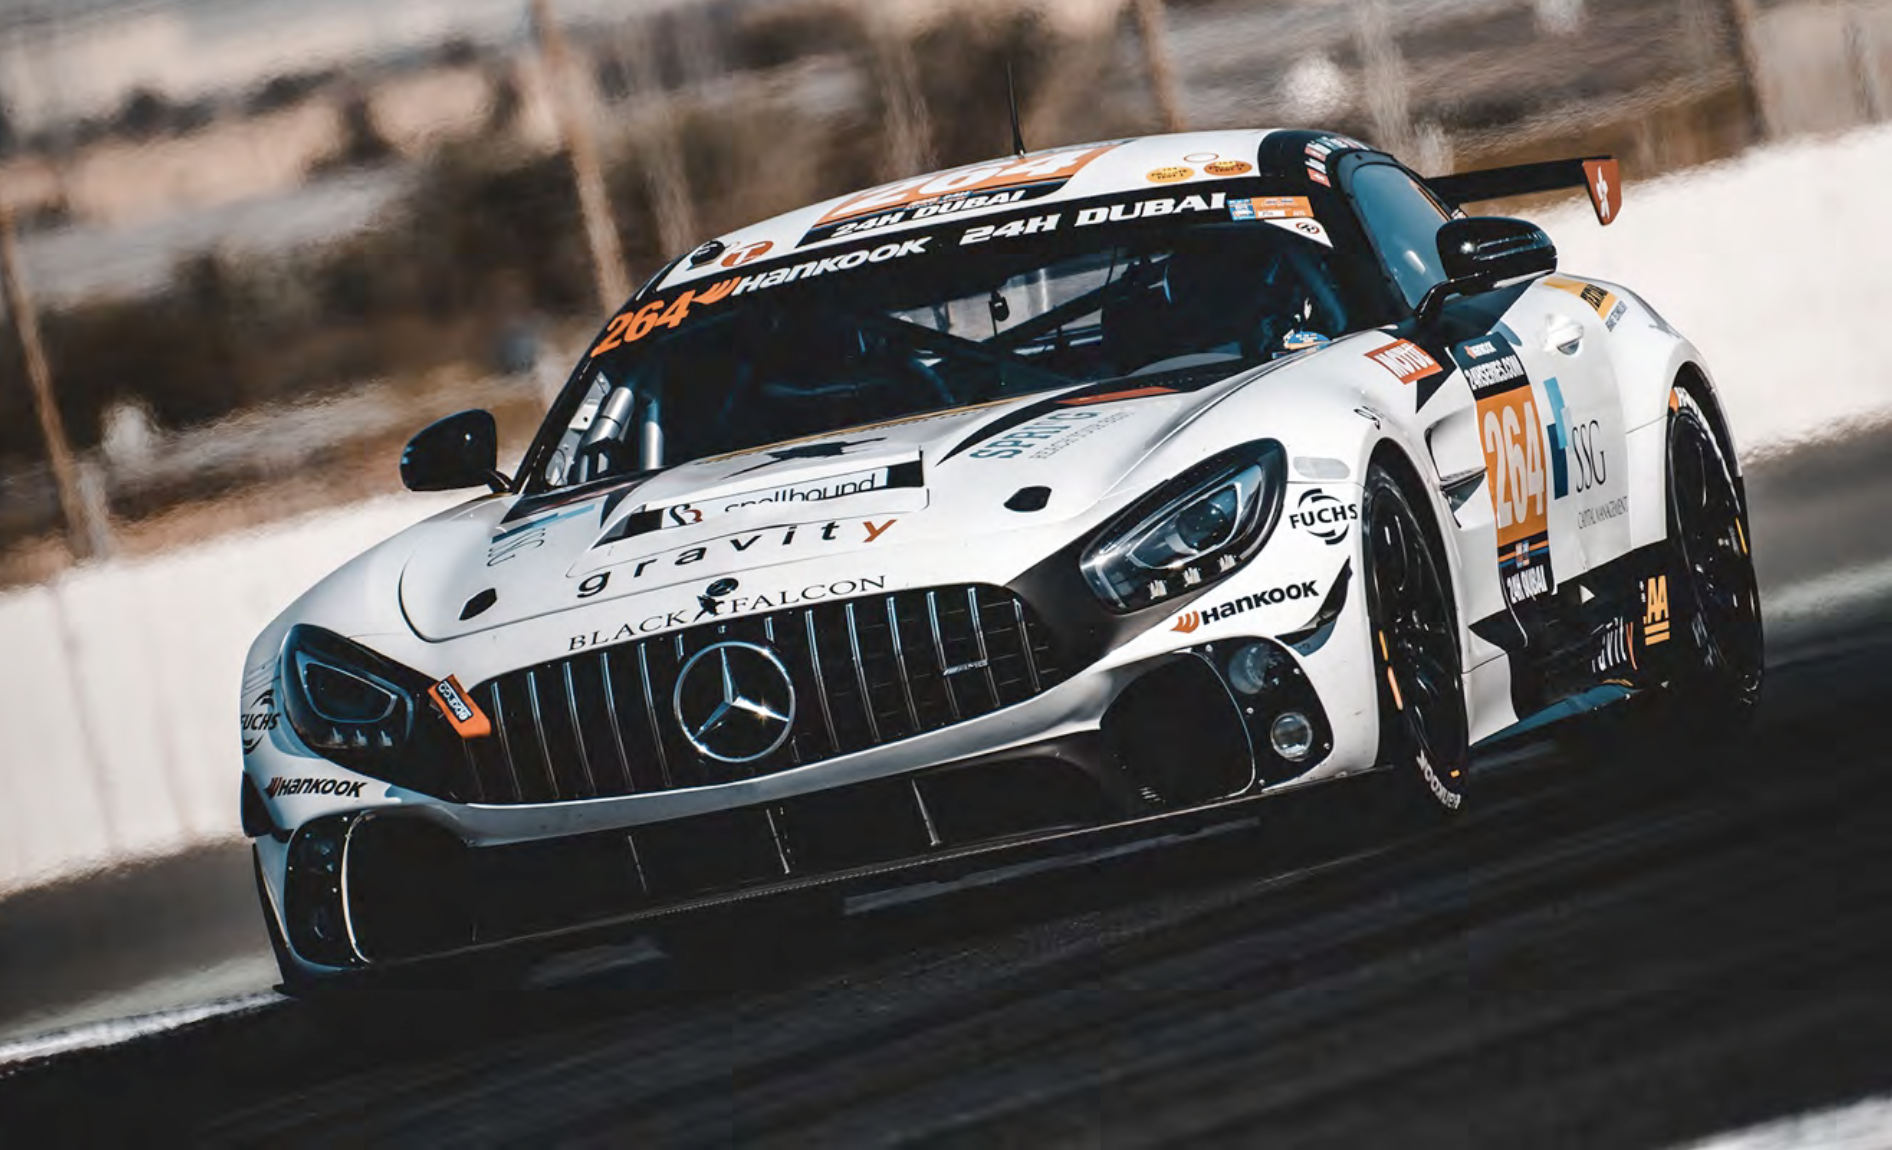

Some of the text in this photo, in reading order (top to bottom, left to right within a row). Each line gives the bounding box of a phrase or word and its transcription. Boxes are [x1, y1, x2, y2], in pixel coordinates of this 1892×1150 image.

[831, 208, 907, 238] 24H
[911, 190, 1027, 218] DUBAI
[591, 290, 697, 358] 264
[959, 214, 1061, 246] 24H
[1074, 192, 1227, 229] DUBAI
[1373, 341, 1435, 379] MOTUL
[1483, 401, 1546, 529] 264
[1572, 420, 1607, 493] SSG
[1289, 504, 1358, 529] FUCHS
[577, 518, 898, 598] gravity
[568, 575, 886, 651] BLACK FALCON
